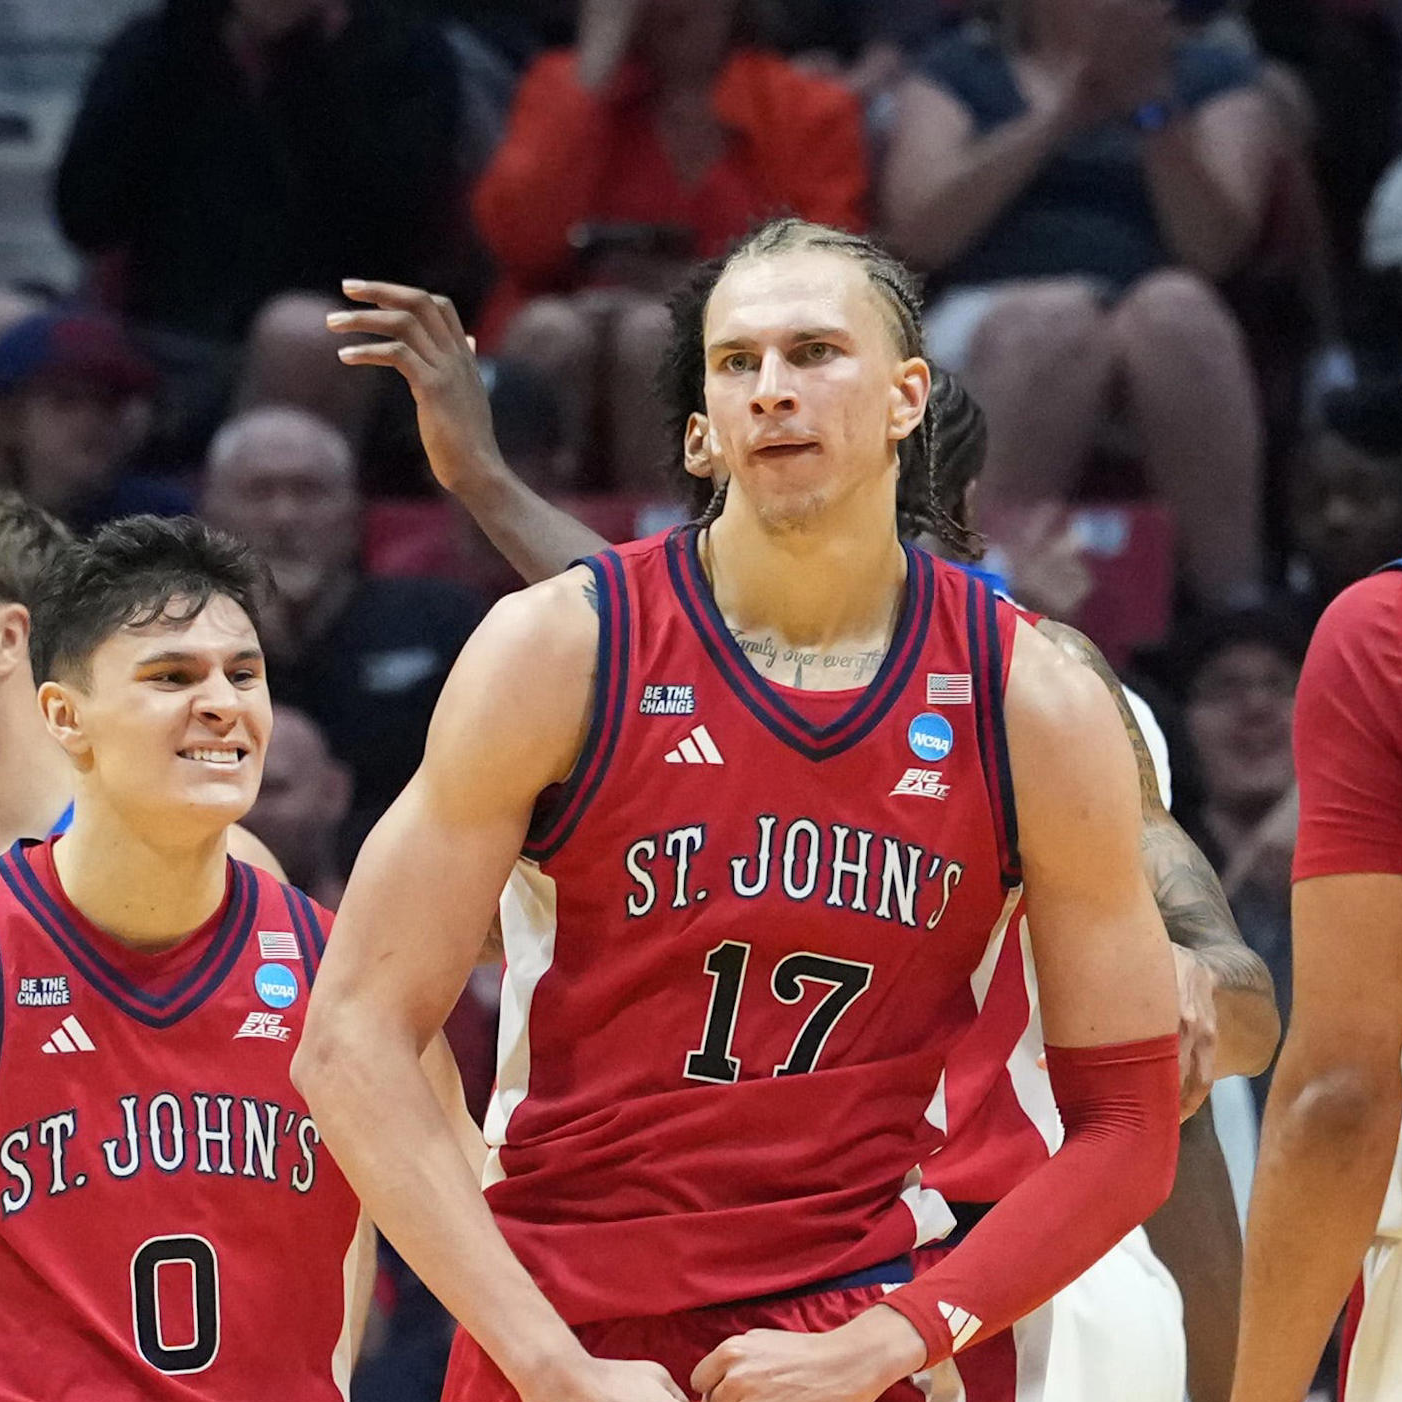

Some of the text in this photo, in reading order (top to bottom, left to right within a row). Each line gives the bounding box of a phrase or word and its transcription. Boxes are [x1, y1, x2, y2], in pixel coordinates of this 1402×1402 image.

[783, 650, 816, 666] over
[644, 685, 693, 699] BE THE
[639, 699, 695, 714] CHANGE
[913, 732, 950, 753] NCAA
[903, 768, 943, 782] BIG
[894, 781, 951, 796] EAST
[622, 814, 964, 930] ST. JOHN'S
[20, 976, 67, 992] BE THE
[261, 982, 296, 999] NCAA
[17, 990, 70, 1006] CHANGE
[246, 1011, 285, 1025] BIG
[683, 939, 874, 1084] 17
[238, 1023, 293, 1038] EAST
[102, 1091, 322, 1195] JOHN'S
[131, 1233, 221, 1375] 0
